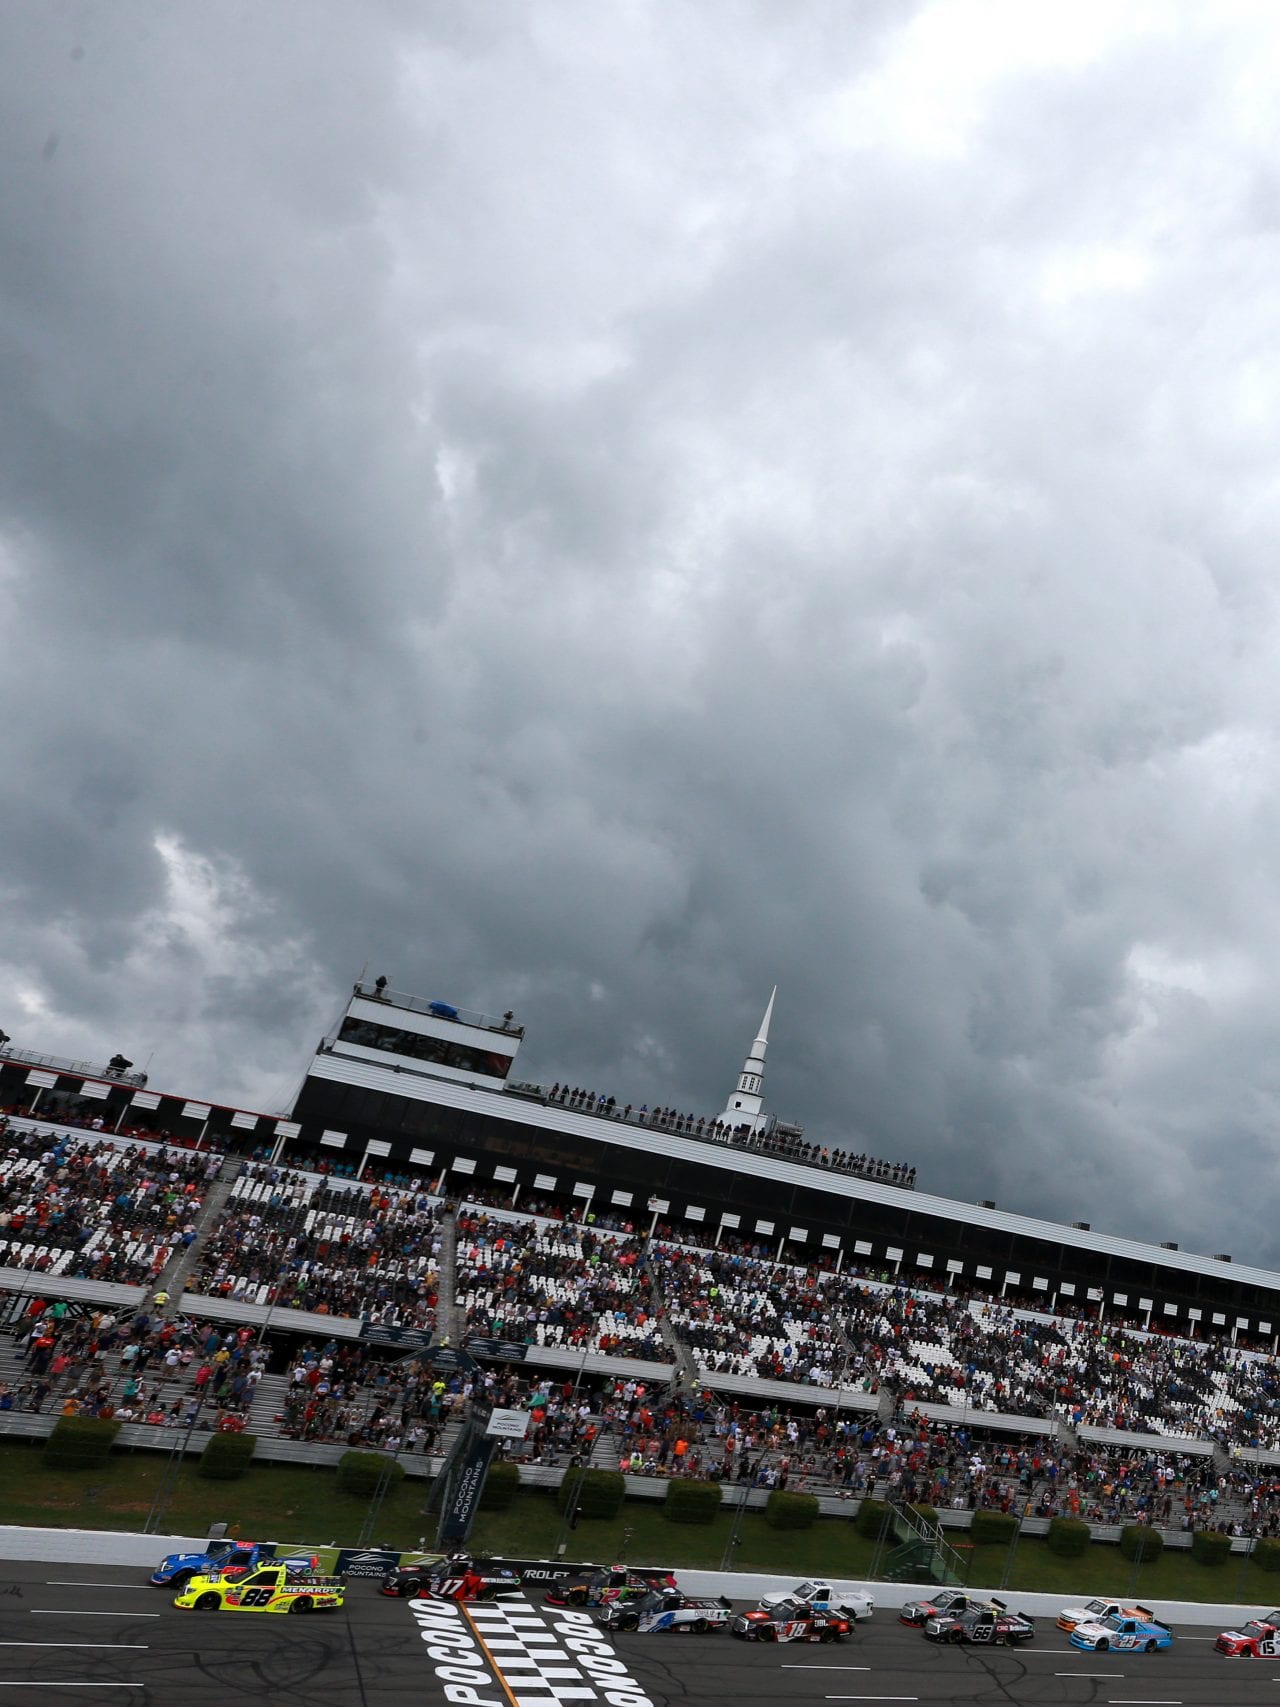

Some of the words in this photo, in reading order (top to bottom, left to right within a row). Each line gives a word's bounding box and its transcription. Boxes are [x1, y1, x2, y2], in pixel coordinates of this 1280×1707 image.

[454, 1467, 473, 1514] POCONO
[459, 1460, 484, 1522] MOUNTAINS
[341, 1570, 387, 1578] MOUNTAINS
[439, 1579, 464, 1595] 17
[240, 1588, 276, 1606] 88
[789, 1623, 807, 1637] 18
[972, 1626, 993, 1640] 66
[1119, 1635, 1136, 1648] 23
[1262, 1641, 1275, 1655] 15
[408, 1599, 505, 1707] POCONO
[540, 1606, 654, 1707] POCONO
